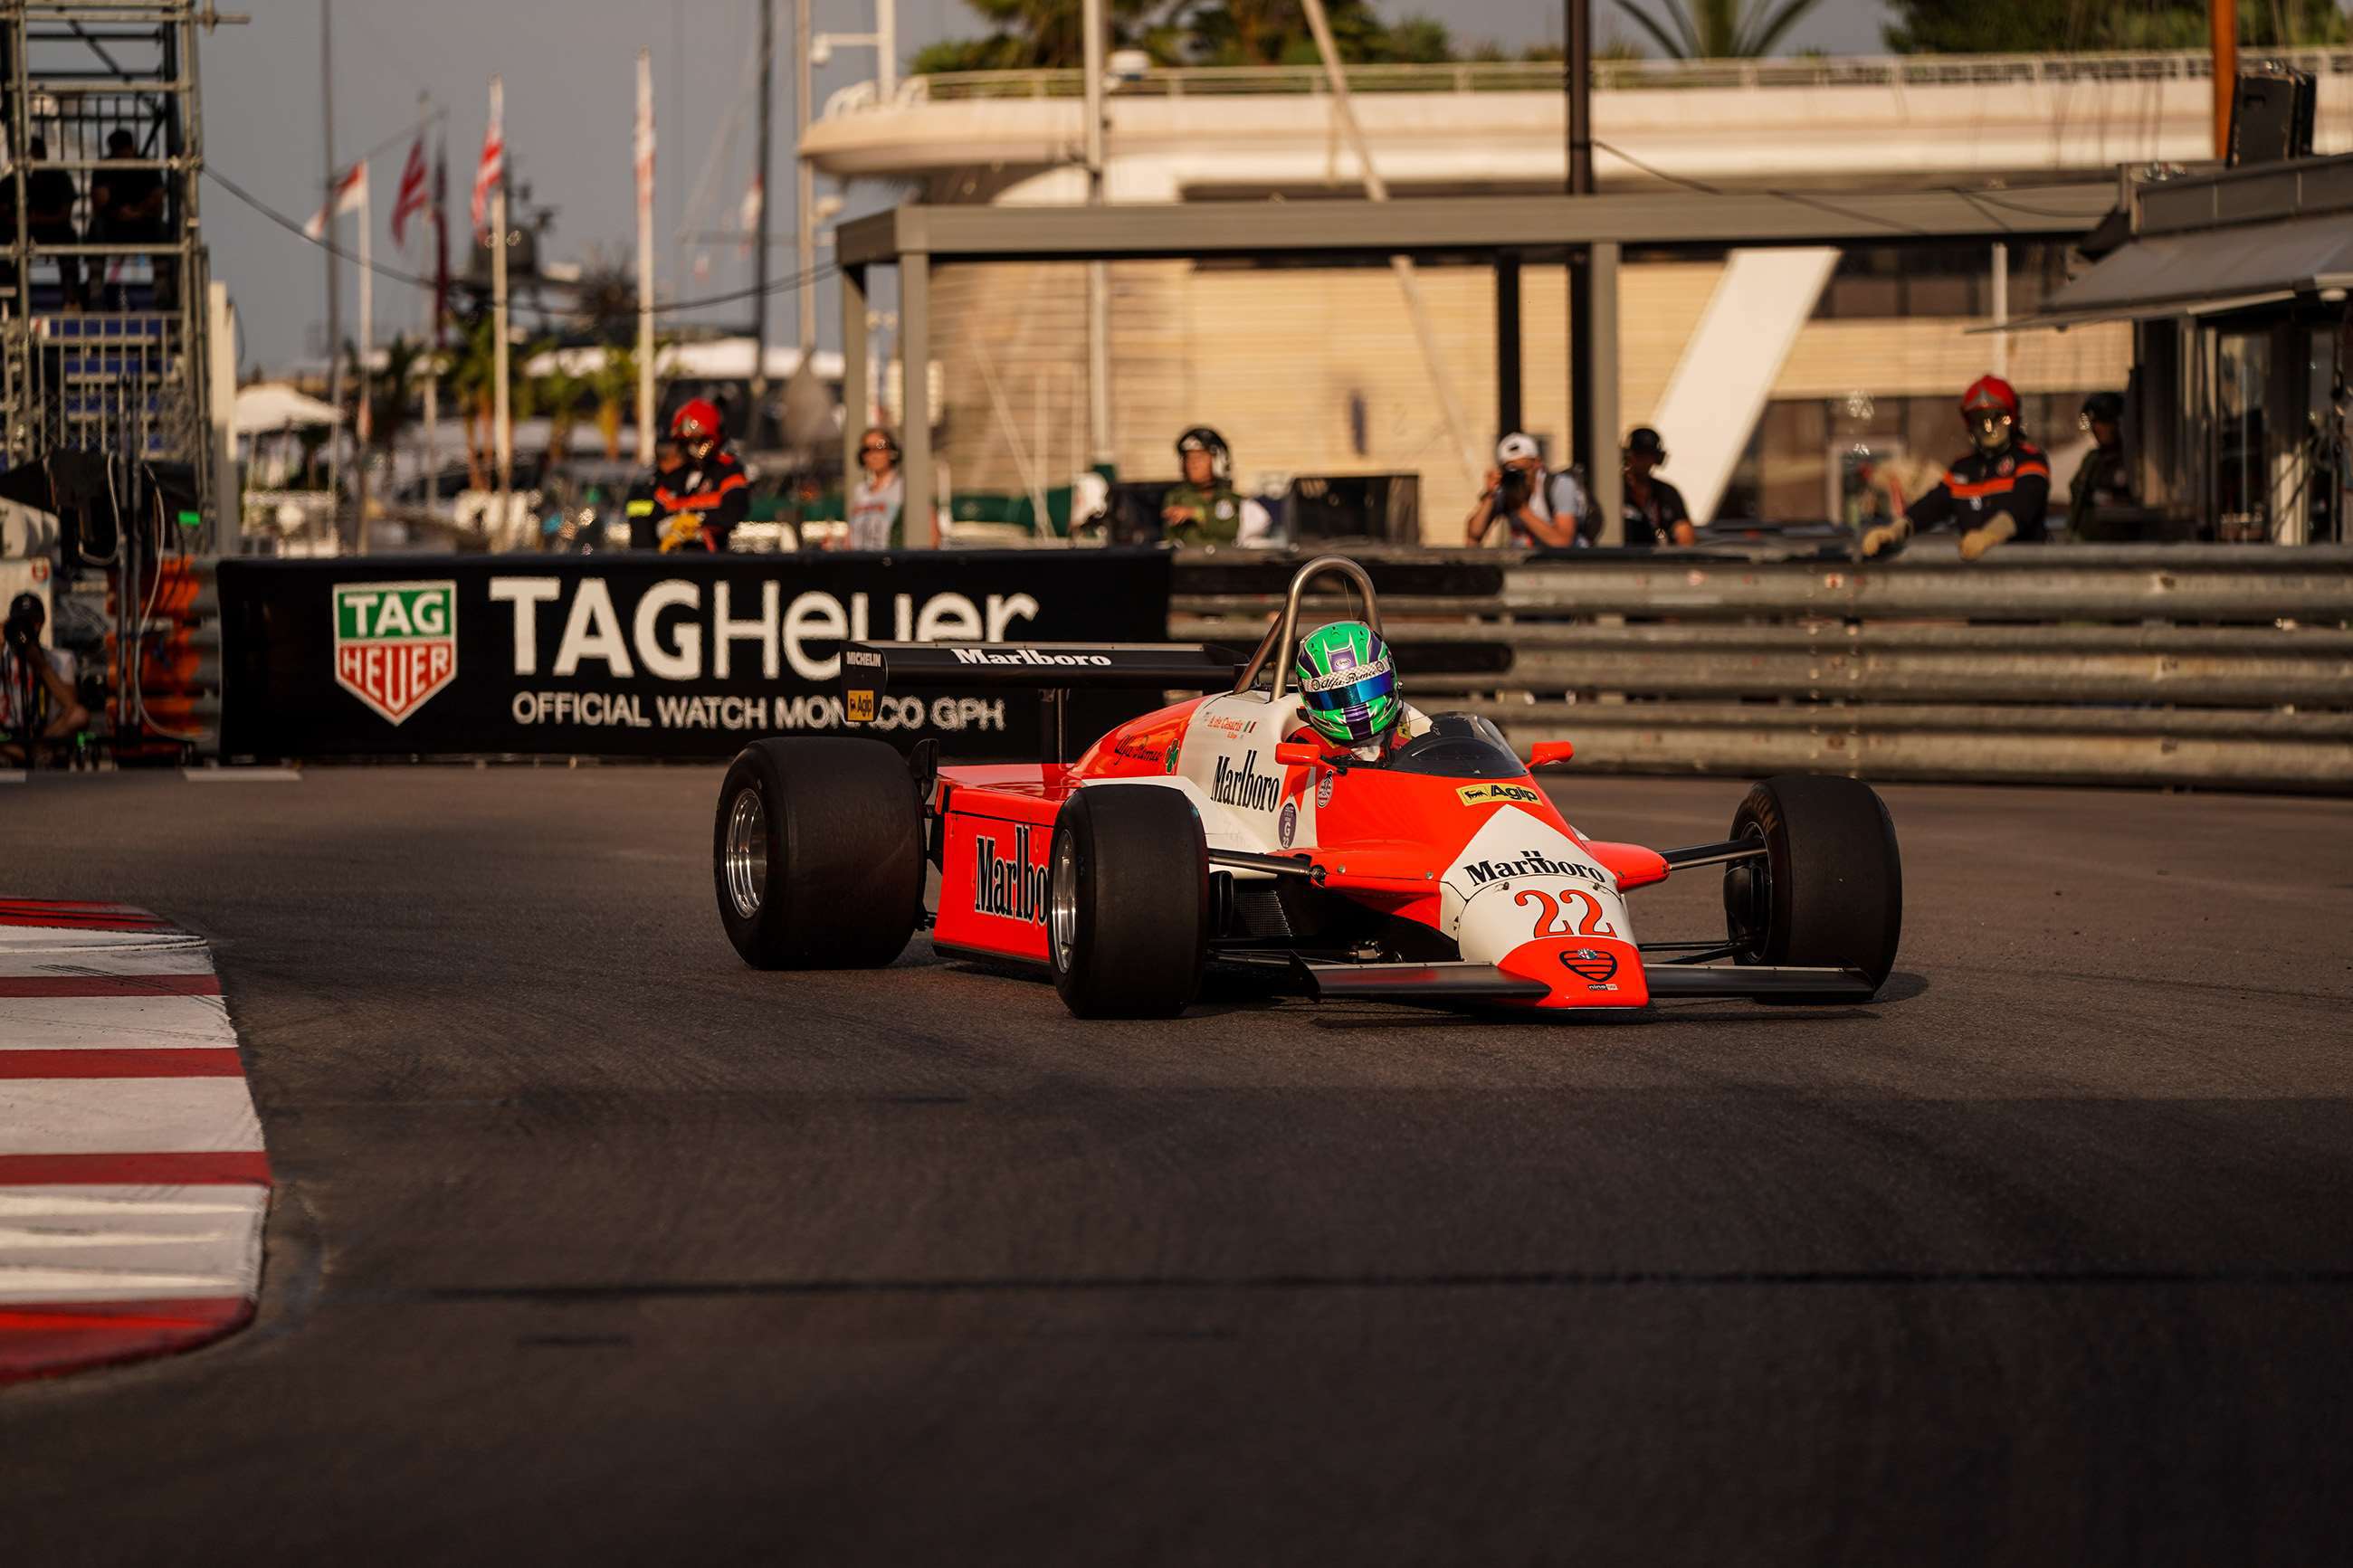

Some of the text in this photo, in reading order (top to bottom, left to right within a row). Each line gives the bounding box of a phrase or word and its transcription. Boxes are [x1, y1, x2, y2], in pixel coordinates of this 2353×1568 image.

[343, 593, 445, 636] TAG
[342, 642, 449, 711] HEUER
[846, 651, 881, 667] MICHELIN
[951, 649, 1111, 666] Marlboro
[512, 690, 1006, 731] OFFICIAL WATCH MONCO GPH
[1210, 749, 1280, 813] Marlboro
[1491, 784, 1538, 802] Agip
[975, 824, 1048, 926] Marlbo
[1463, 851, 1606, 886] Marlboro
[1514, 889, 1617, 938] 22
